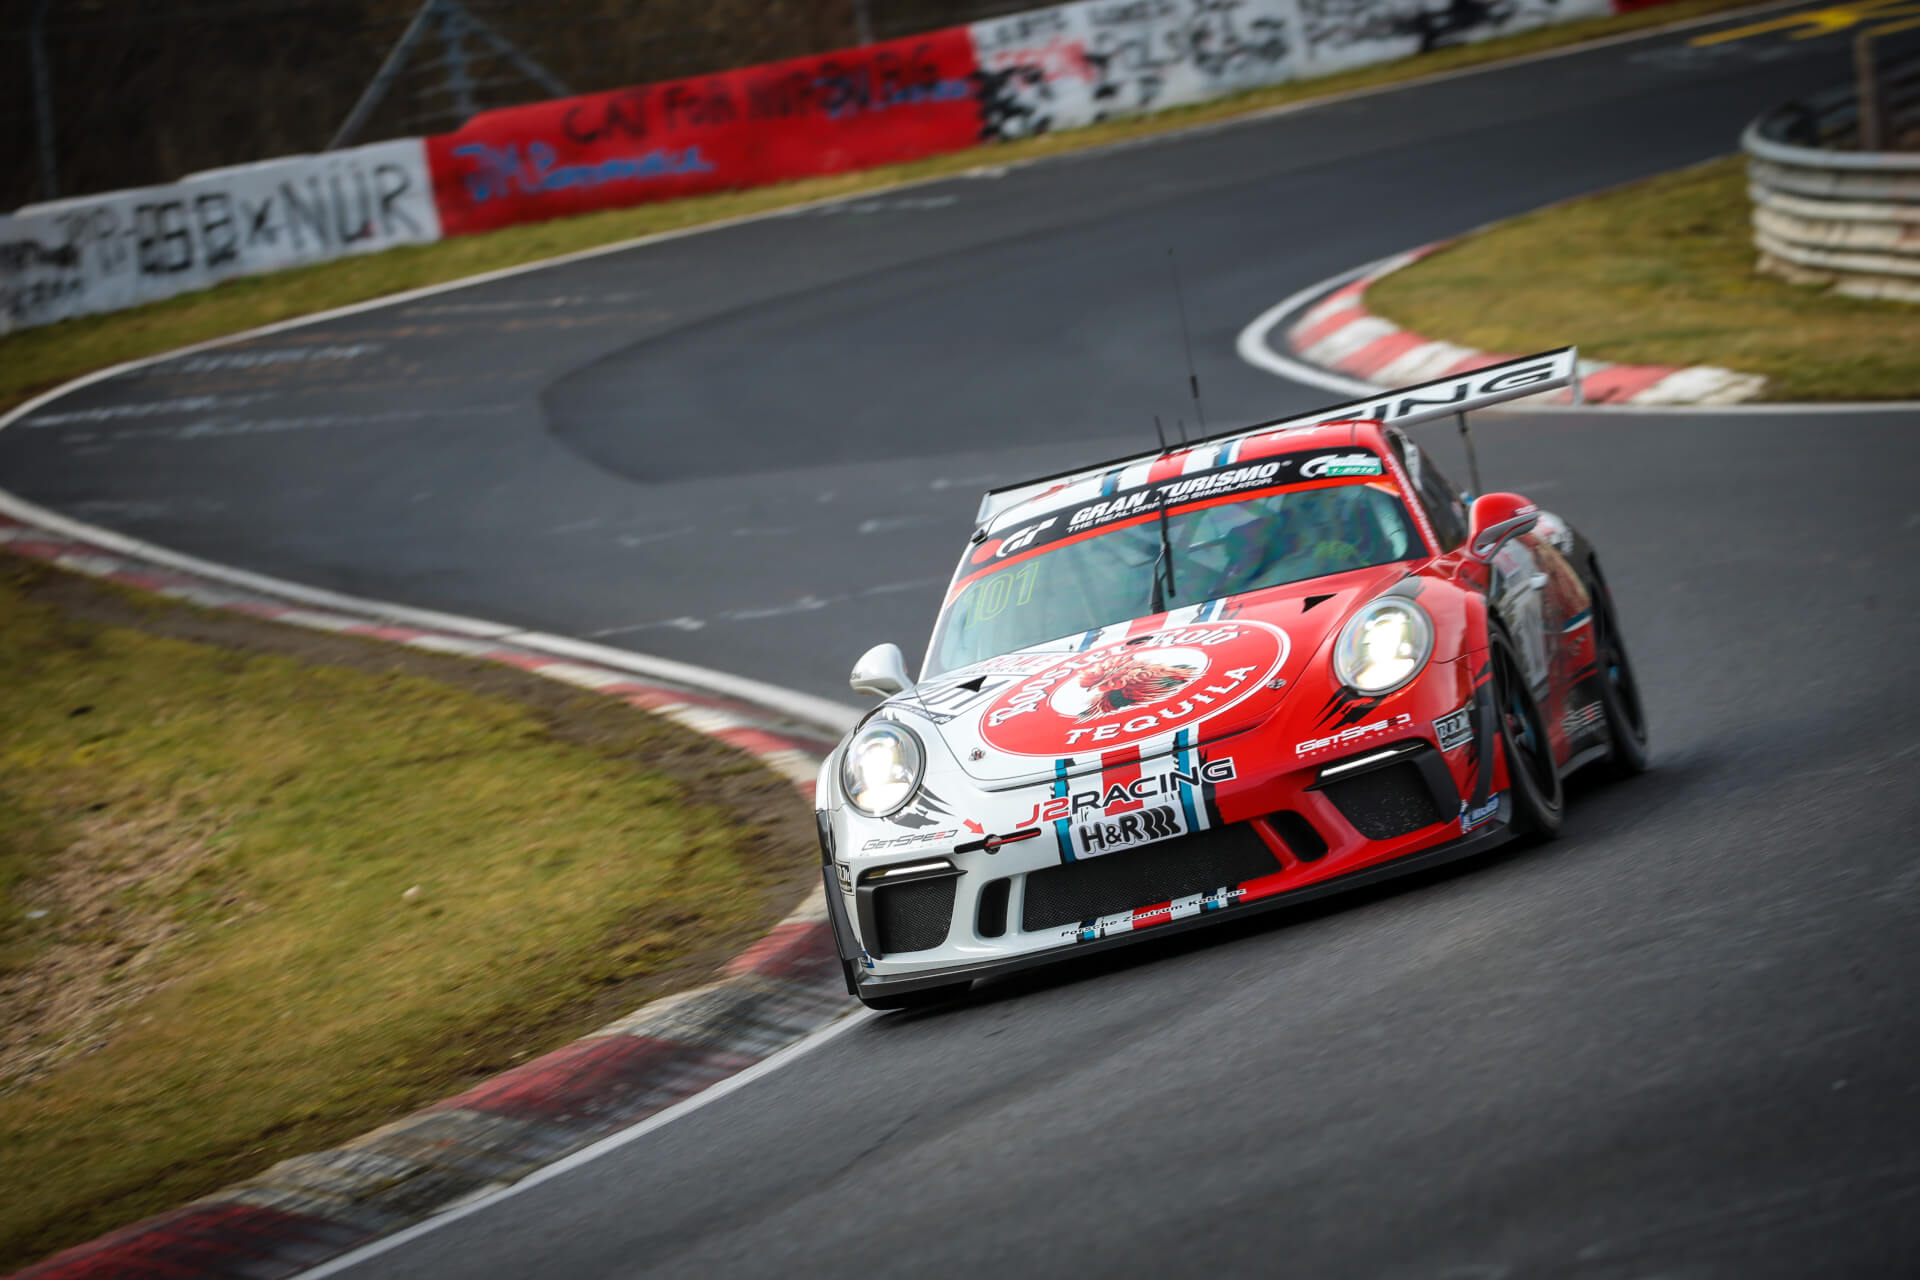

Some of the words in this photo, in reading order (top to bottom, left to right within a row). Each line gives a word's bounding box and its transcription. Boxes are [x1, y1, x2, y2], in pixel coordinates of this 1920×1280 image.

[1066, 519, 1094, 533] THE
[1094, 511, 1131, 524] REAL
[1189, 477, 1273, 499] SIMULATOR
[1069, 490, 1151, 526] GRAN
[1157, 461, 1281, 498] TURISMO
[963, 561, 1041, 630] 101
[1065, 665, 1258, 745] TEQUILA
[1060, 917, 1118, 937] Porsche
[1122, 904, 1184, 923] Zentrum
[1188, 888, 1247, 907] Koblenz
